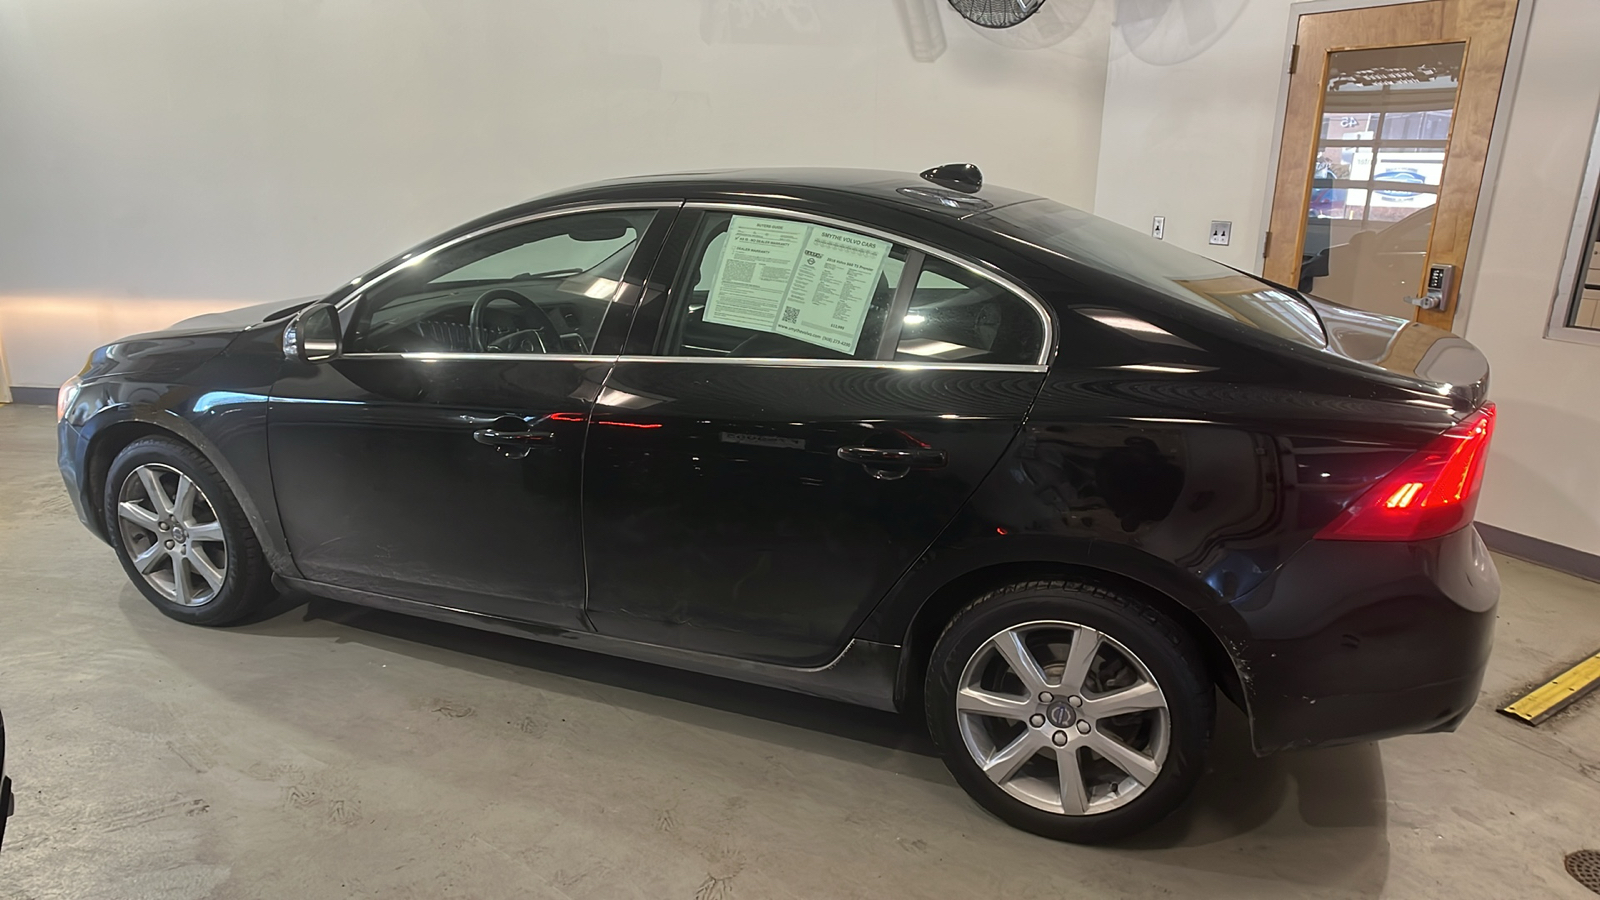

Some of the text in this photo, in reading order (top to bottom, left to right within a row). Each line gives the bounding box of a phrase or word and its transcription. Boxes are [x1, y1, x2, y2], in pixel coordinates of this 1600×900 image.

[821, 232, 842, 240] SMYTHE
[842, 237, 861, 246] VOLVO
[862, 241, 876, 249] CARS
[778, 324, 822, 339] www.smythevolvo.com
